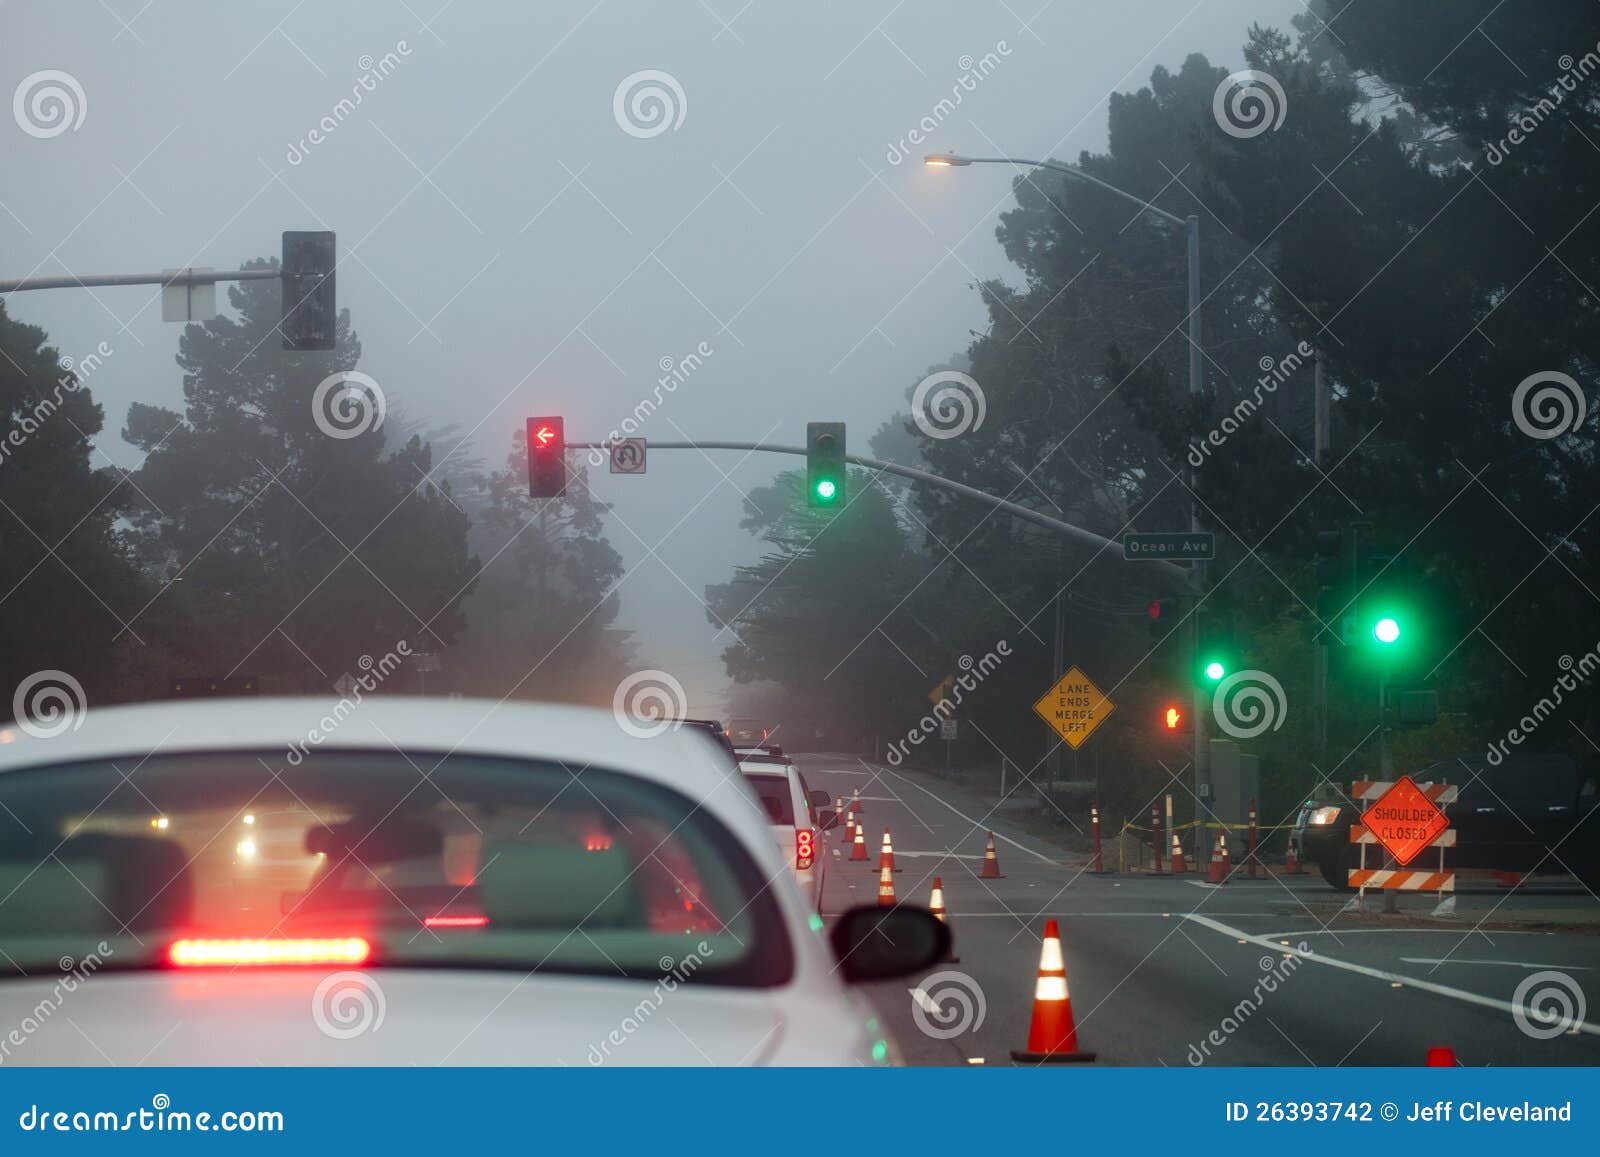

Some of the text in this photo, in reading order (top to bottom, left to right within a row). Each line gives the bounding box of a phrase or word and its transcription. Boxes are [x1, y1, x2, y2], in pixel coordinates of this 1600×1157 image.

[1130, 541, 1208, 552] Ocean Ave
[1060, 684, 1090, 694] LANE
[1060, 697, 1090, 707] ENDS
[1055, 710, 1094, 720] MERGE
[1062, 722, 1087, 733] LEFT
[1375, 807, 1435, 823] SHOULDER
[1382, 827, 1427, 840] CLOSED
